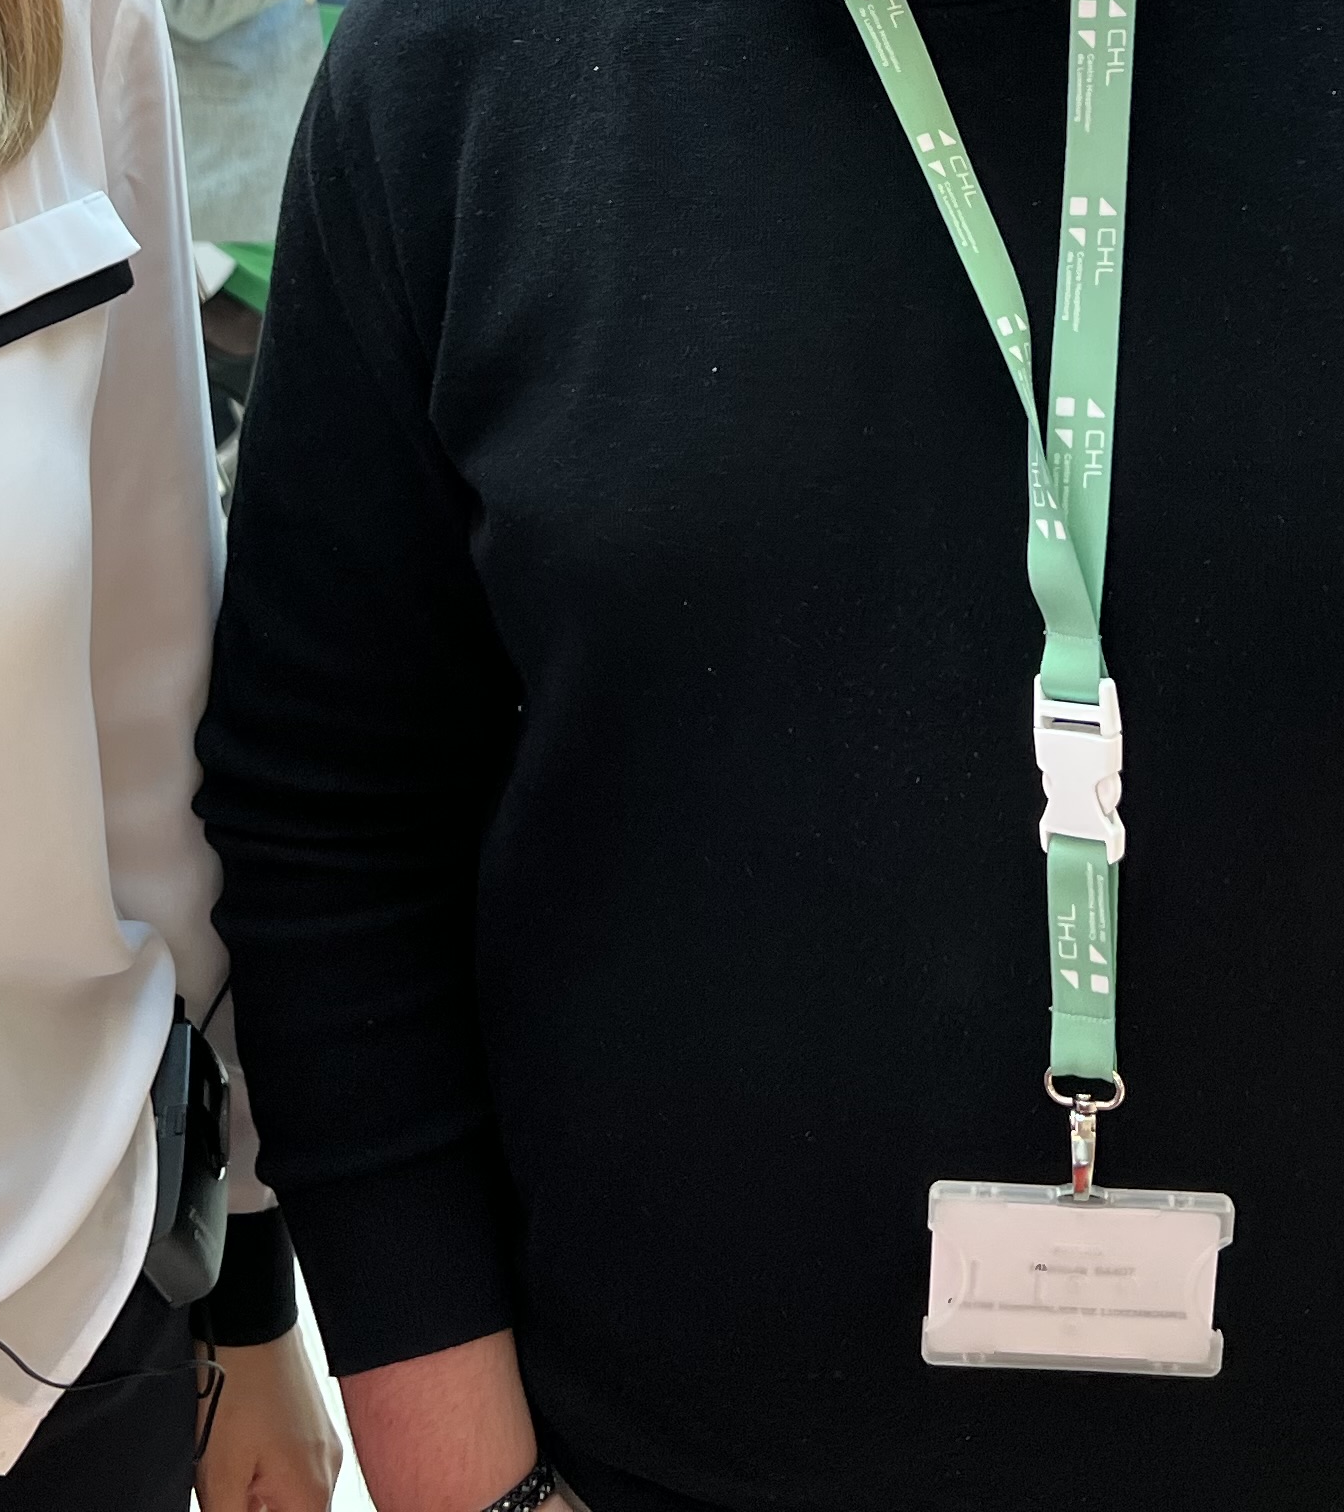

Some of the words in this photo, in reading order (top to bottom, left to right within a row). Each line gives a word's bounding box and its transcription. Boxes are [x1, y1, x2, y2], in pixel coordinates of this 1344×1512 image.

[1106, 29, 1126, 87] CHL
[949, 155, 977, 209] CHL
[1095, 228, 1116, 286] CHL
[1083, 430, 1105, 488] CHL
[1057, 903, 1077, 959] CHL
